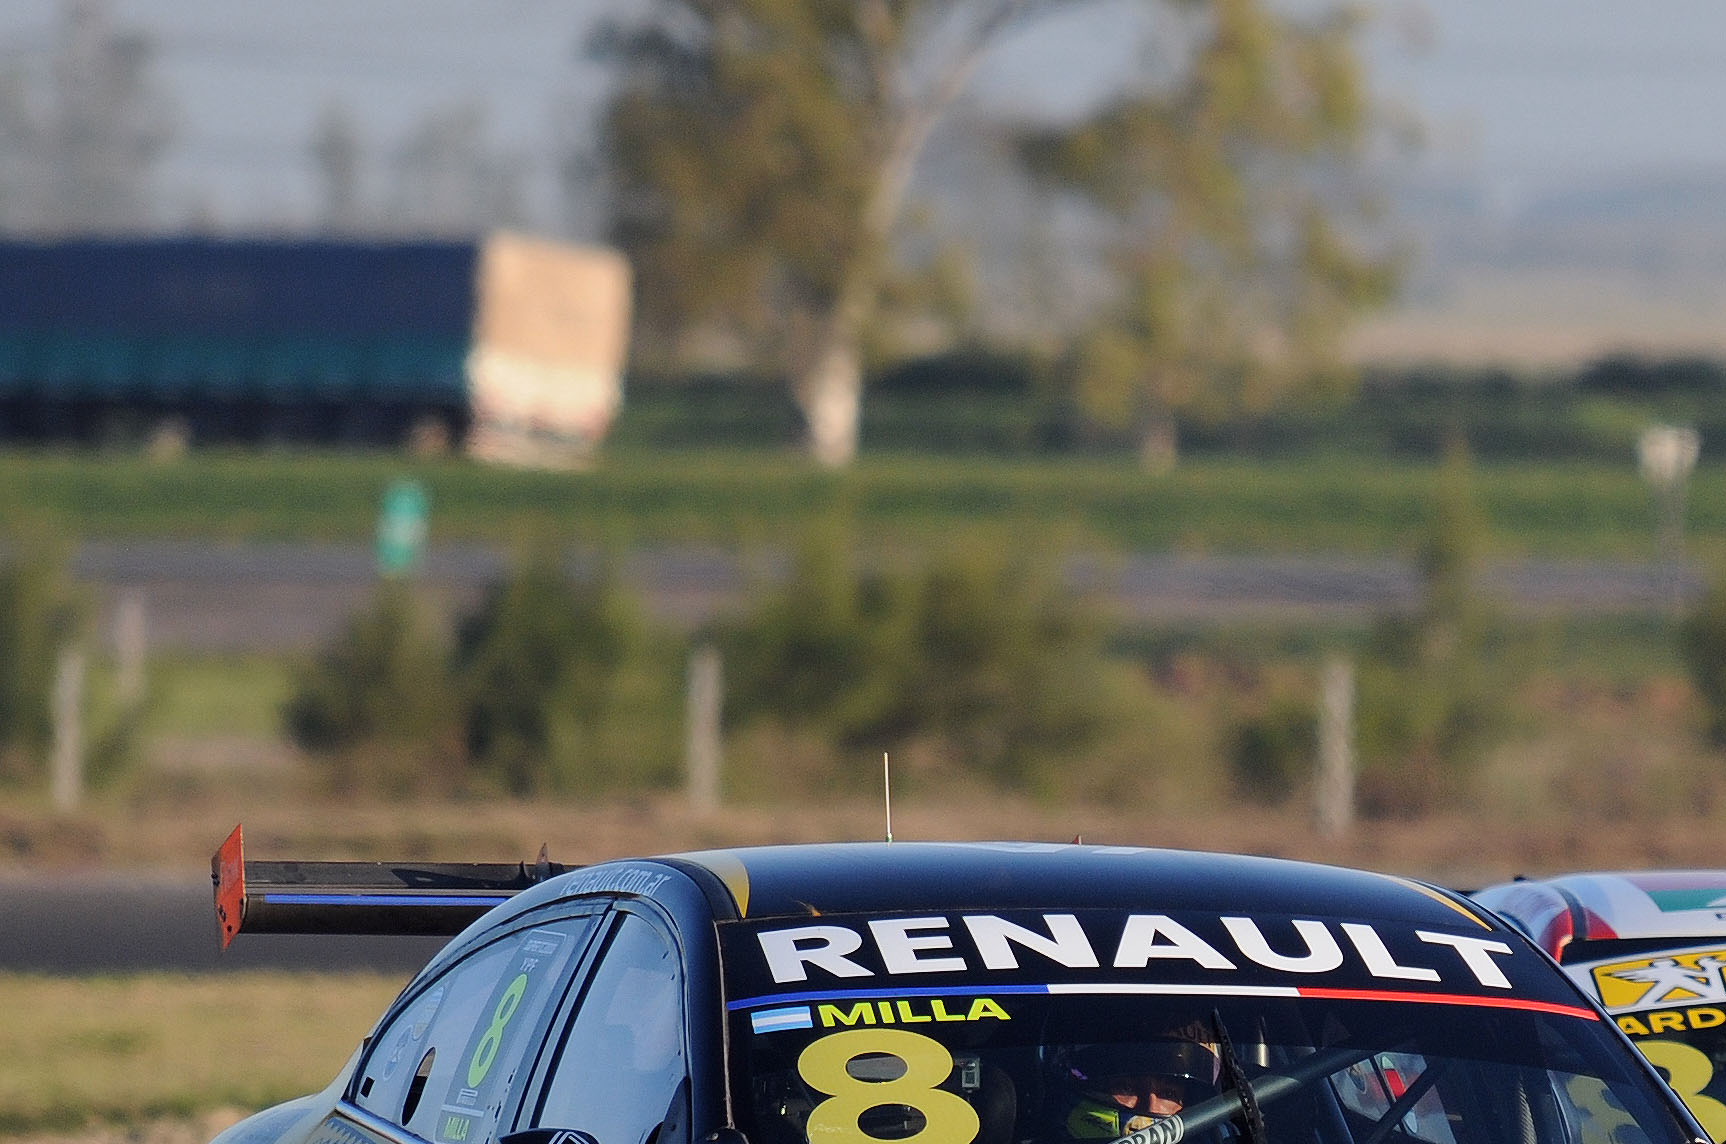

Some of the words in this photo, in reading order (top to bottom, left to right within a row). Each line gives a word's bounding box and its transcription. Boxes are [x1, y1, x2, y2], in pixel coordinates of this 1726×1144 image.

[757, 914, 1514, 989] RENAULT
[468, 973, 528, 1088] 8
[818, 998, 1011, 1027] MILLA
